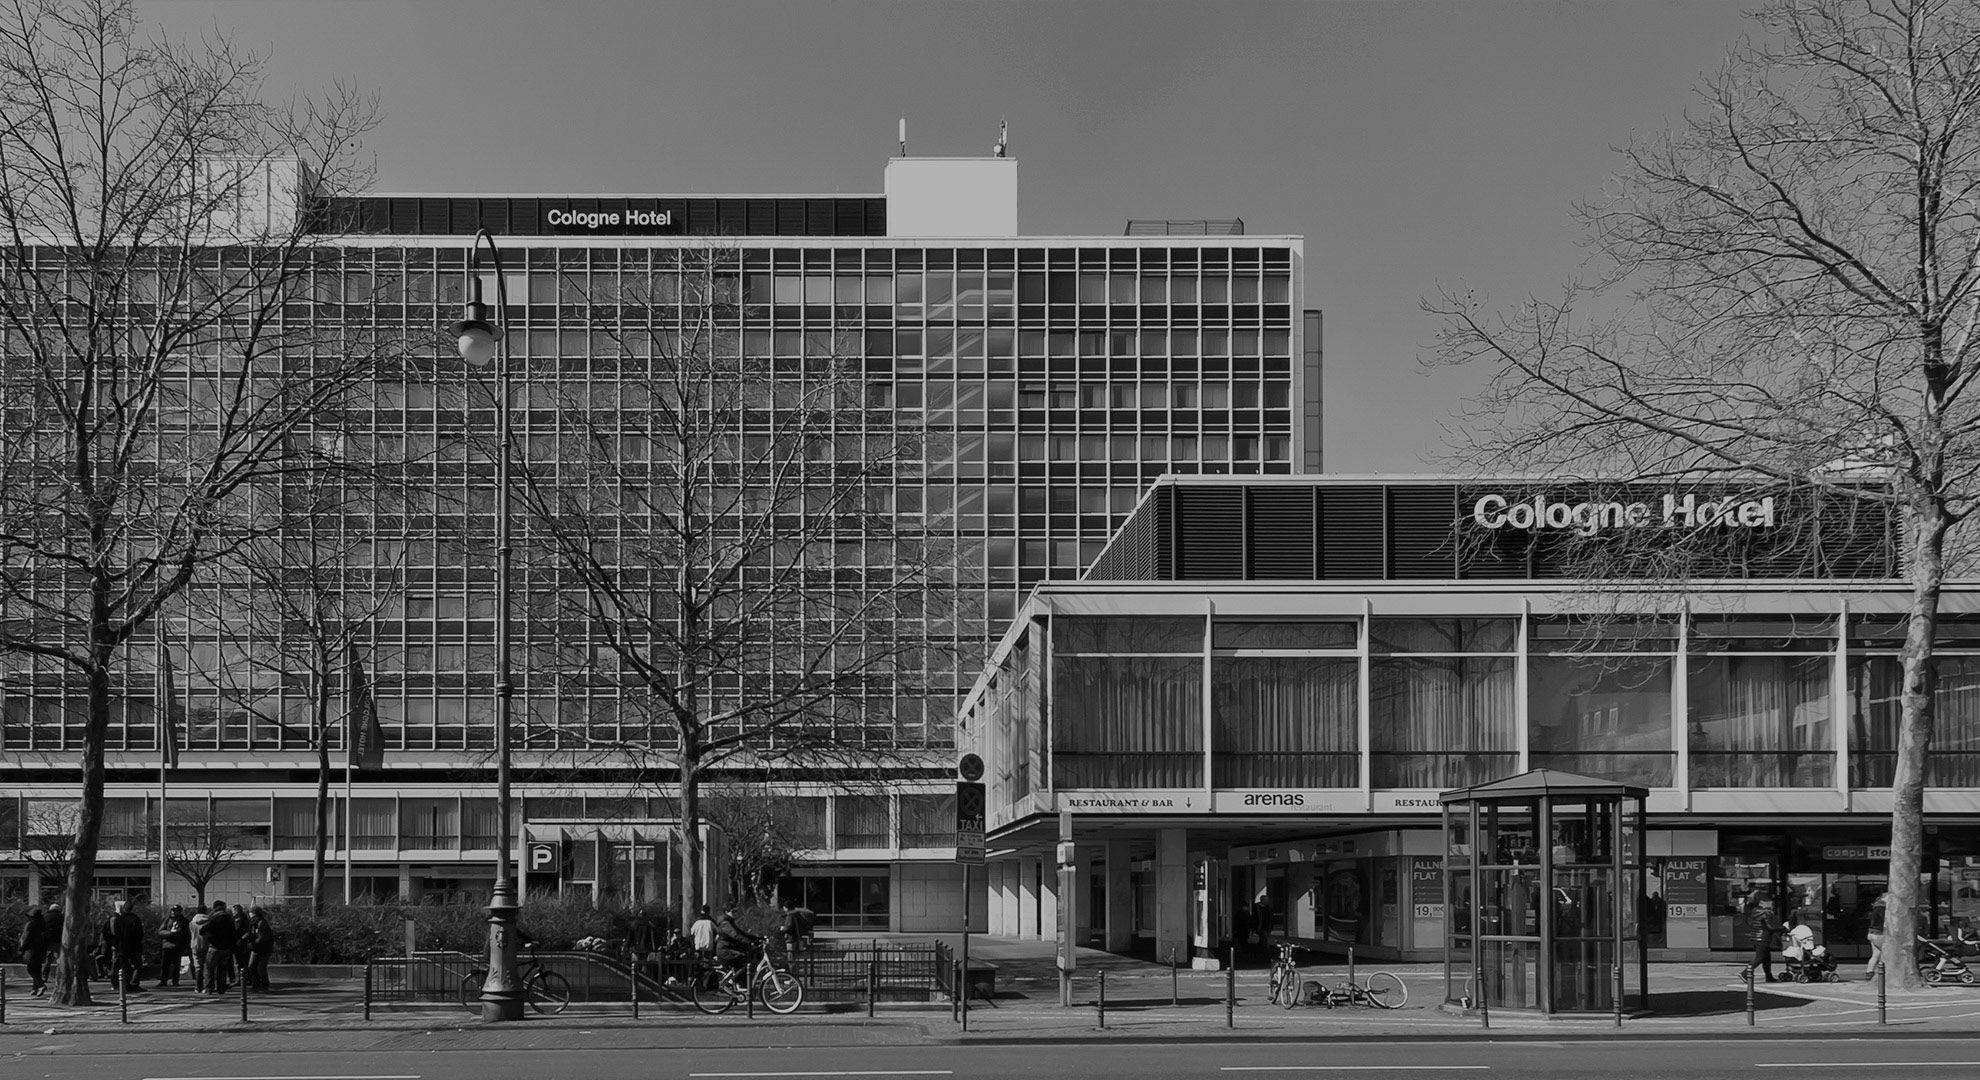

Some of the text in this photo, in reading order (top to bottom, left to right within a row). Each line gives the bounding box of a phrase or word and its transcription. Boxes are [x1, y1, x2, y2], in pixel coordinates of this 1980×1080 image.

[547, 209, 671, 228] Cologne Hotel
[1473, 493, 1774, 537] Cologne Hotel
[1069, 799, 1174, 807] RESTAURANT & BAR
[1244, 793, 1304, 806] arenas
[1395, 799, 1443, 807] RESTAUR
[960, 819, 983, 831] TAXI
[1827, 849, 1865, 858] compu
[532, 849, 552, 870] P
[1414, 861, 1444, 870] ALLNE
[1667, 861, 1706, 870] ALLNET
[1413, 872, 1437, 881] FLAT
[1666, 872, 1690, 881] FLAT
